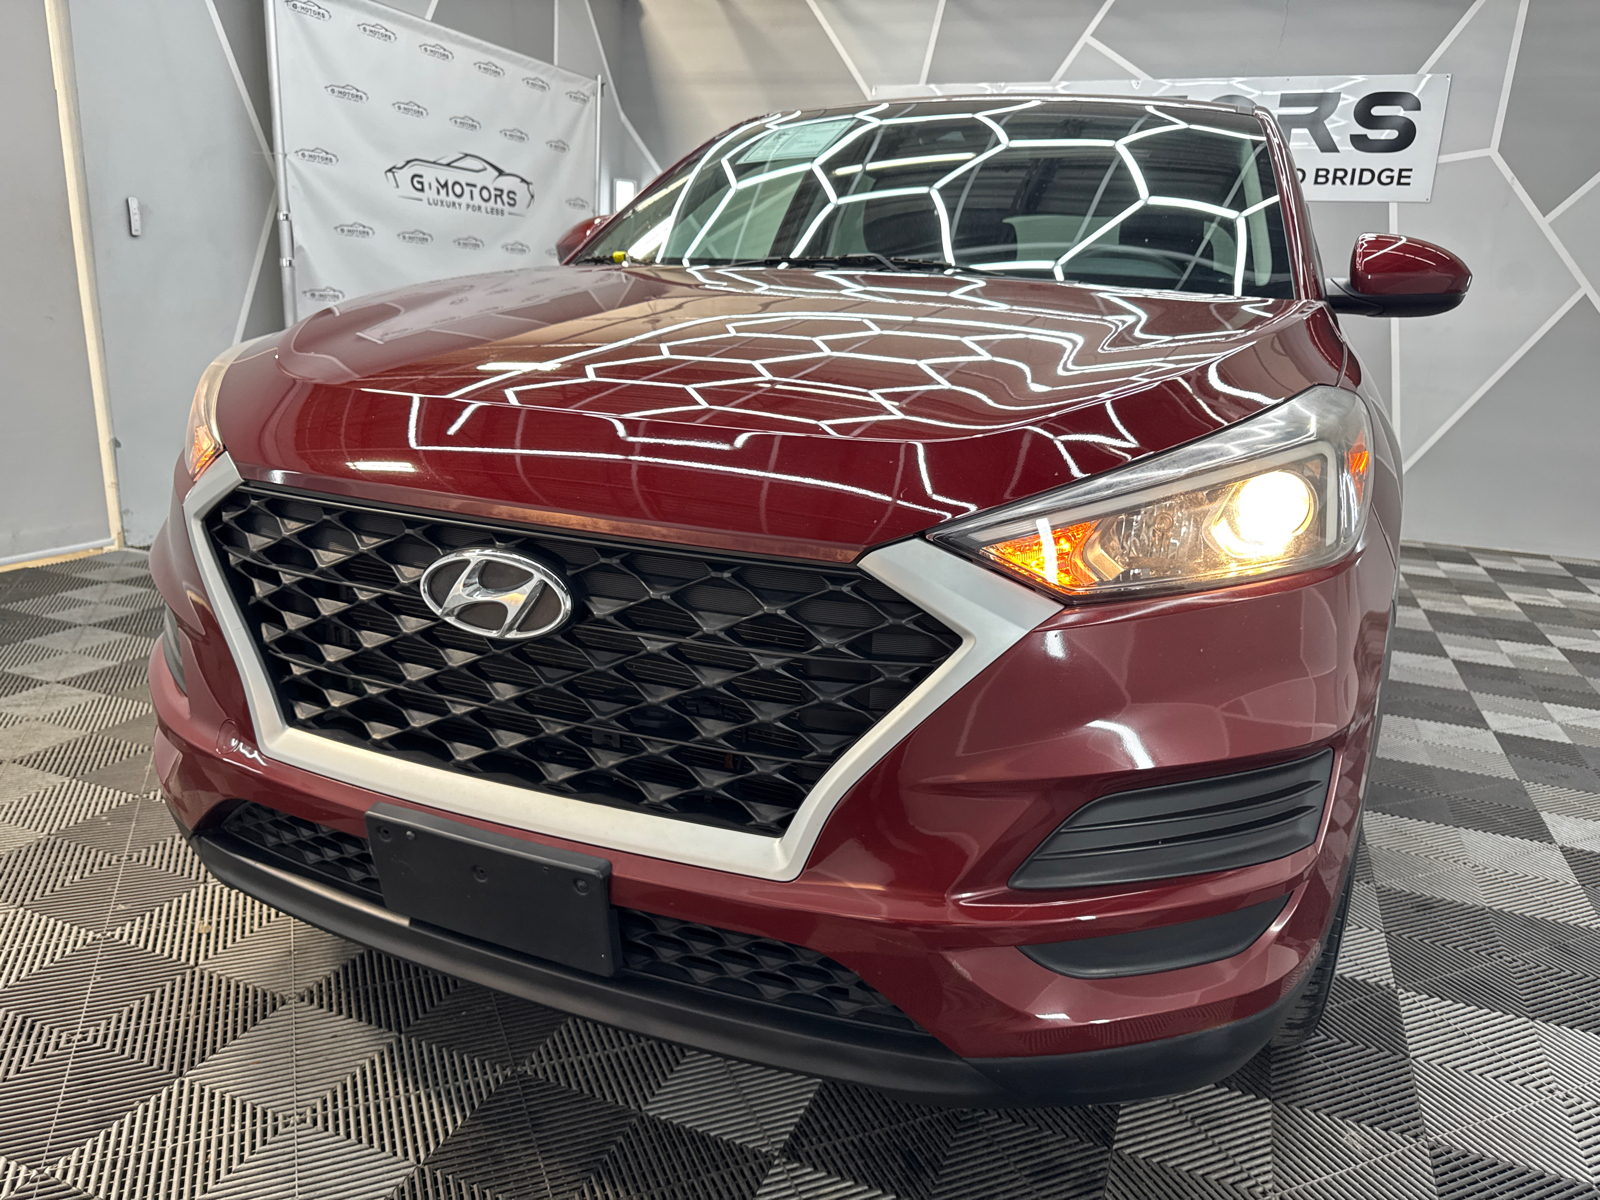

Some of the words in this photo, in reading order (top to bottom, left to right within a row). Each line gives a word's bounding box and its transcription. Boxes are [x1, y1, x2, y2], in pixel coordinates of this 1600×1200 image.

[1313, 167, 1413, 186] BRIDGE
[426, 197, 462, 210] LUXURY
[466, 203, 482, 214] FOR
[485, 206, 505, 217] LESS
